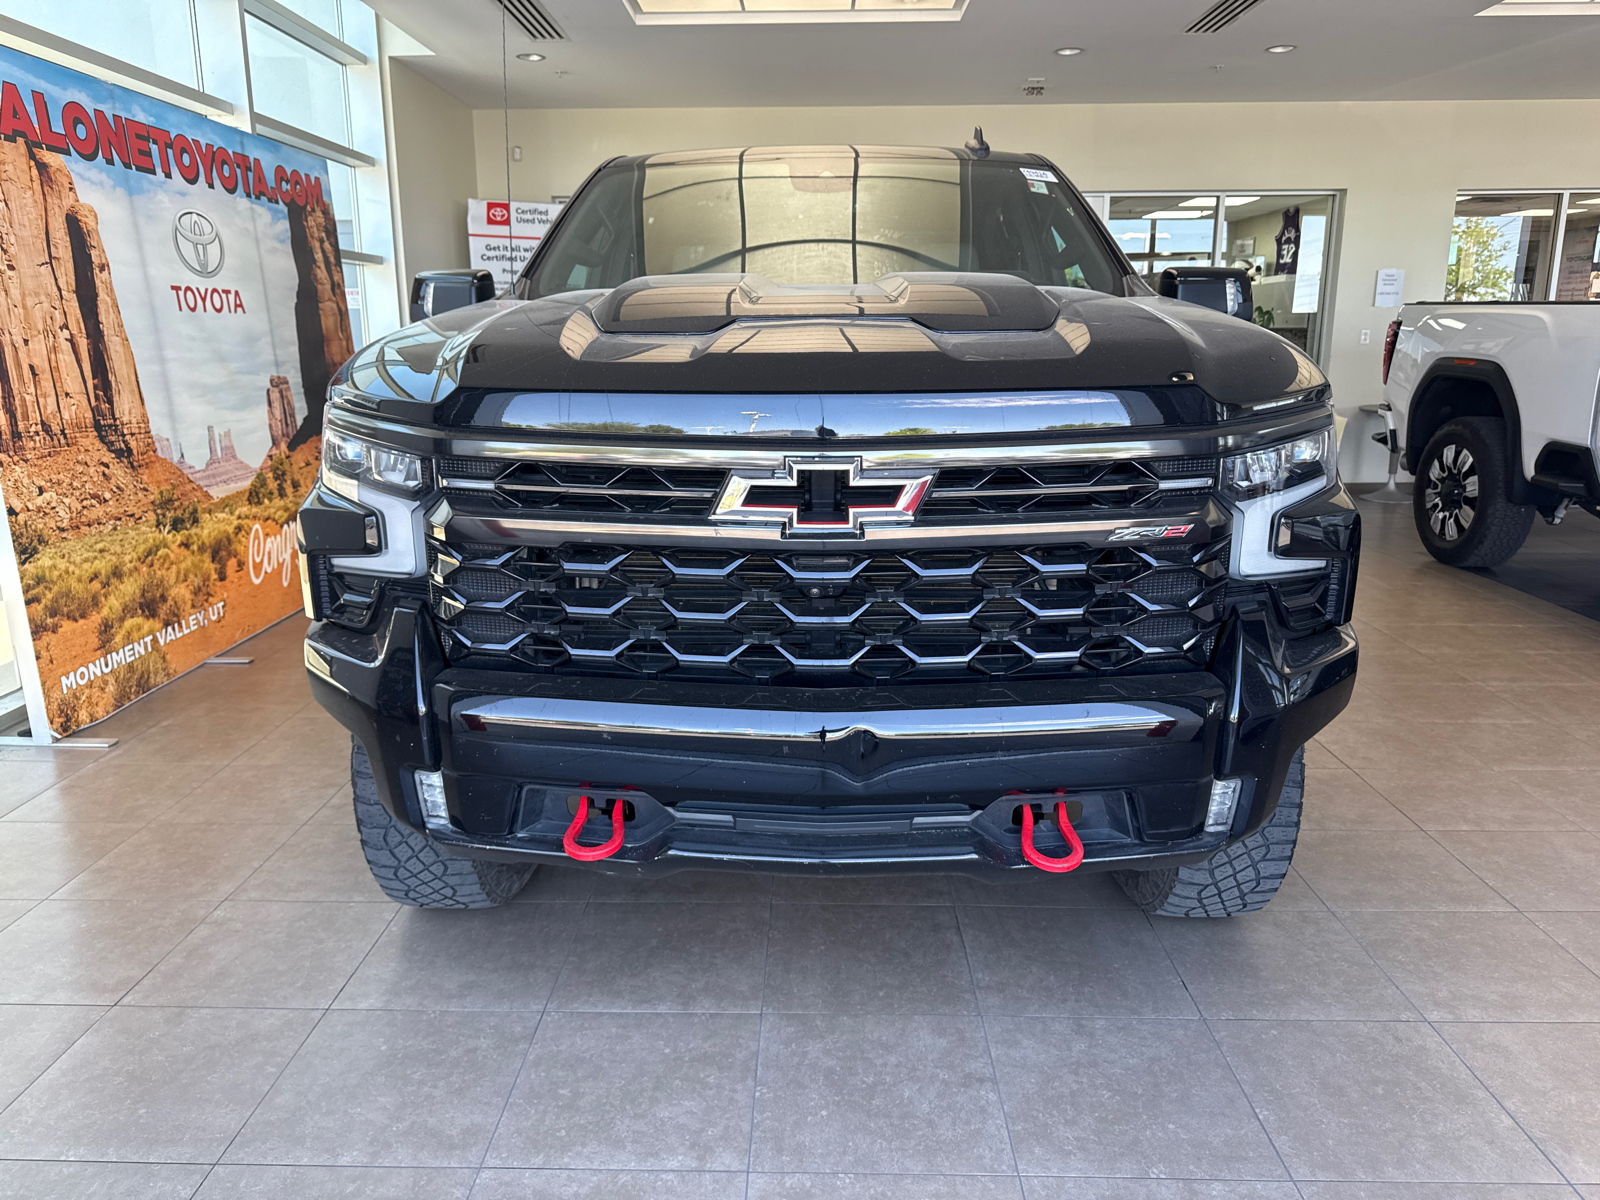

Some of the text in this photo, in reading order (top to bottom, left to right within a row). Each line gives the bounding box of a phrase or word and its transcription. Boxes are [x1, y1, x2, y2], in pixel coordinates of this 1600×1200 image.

[516, 208, 548, 216] Certified
[516, 216, 535, 224] Used
[485, 244, 500, 252] Get
[503, 243, 509, 252] it
[511, 245, 521, 253] all
[1279, 244, 1295, 263] 32
[481, 254, 517, 262] Certified
[170, 284, 247, 315] TOYOTA
[1105, 523, 1194, 542] ZR2
[60, 601, 225, 695] MONUMENT VALLEY, UT
